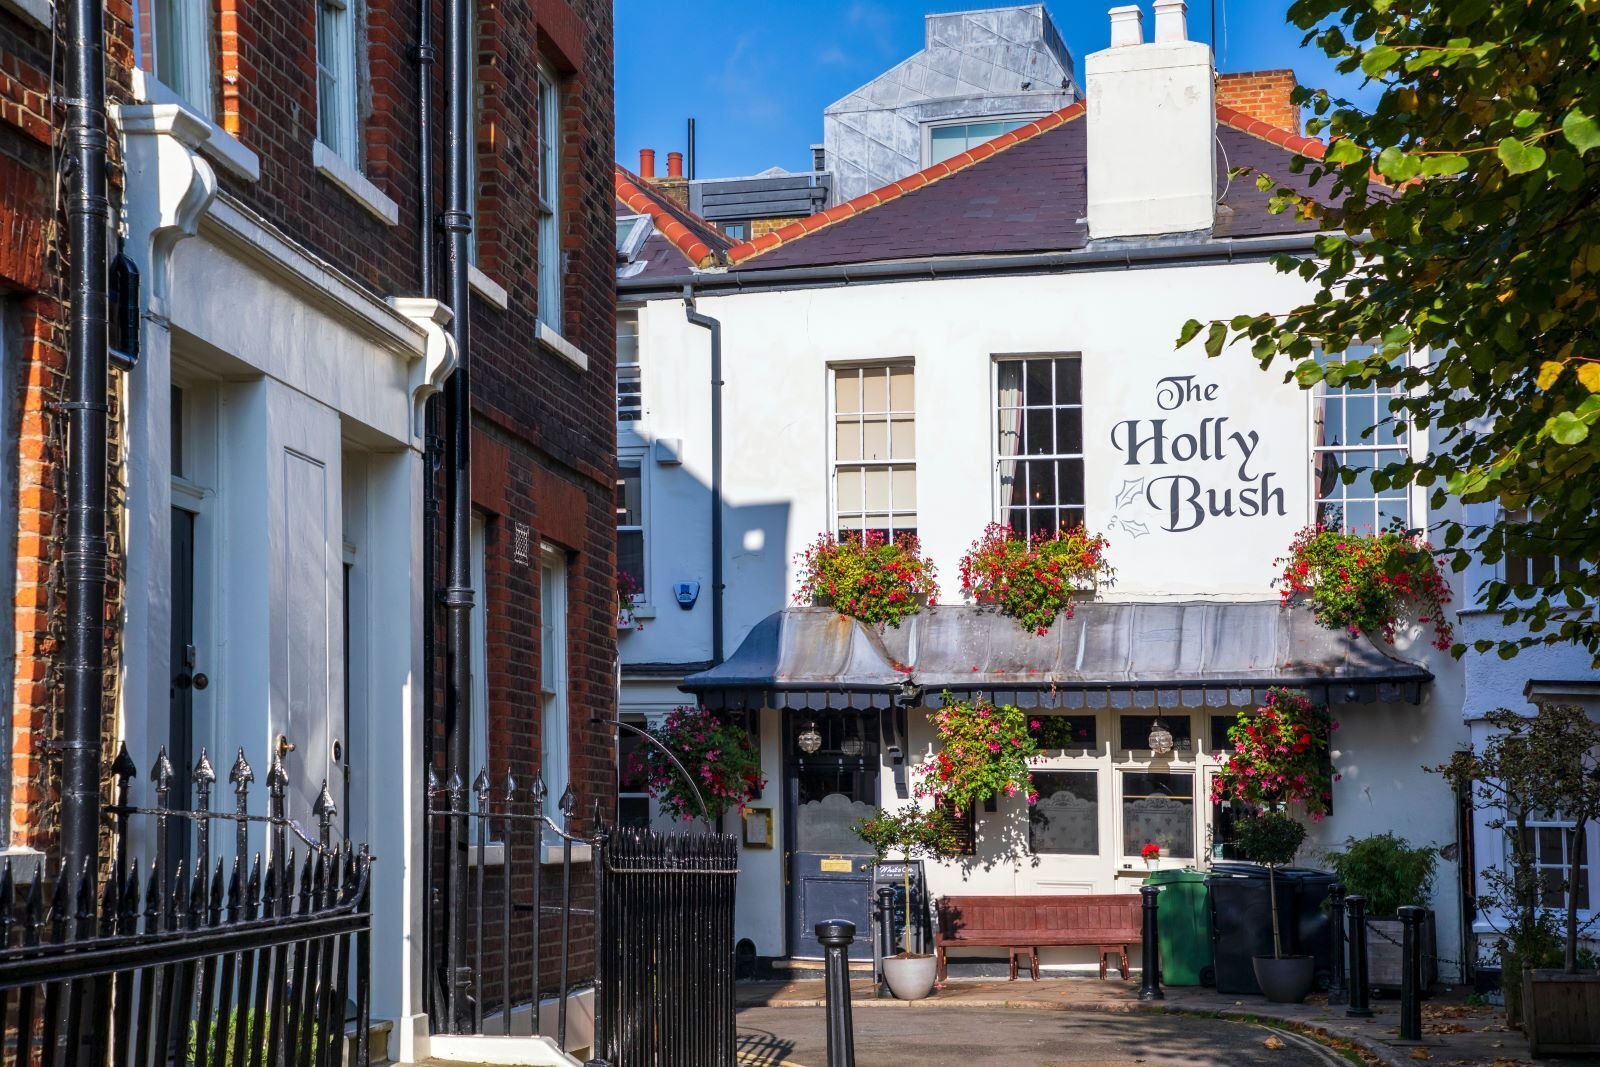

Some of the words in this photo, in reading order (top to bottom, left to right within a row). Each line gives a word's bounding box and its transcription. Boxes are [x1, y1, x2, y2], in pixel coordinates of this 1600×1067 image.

[1156, 375, 1219, 410] The
[1111, 417, 1259, 482] Holly
[1147, 472, 1287, 532] Bush
